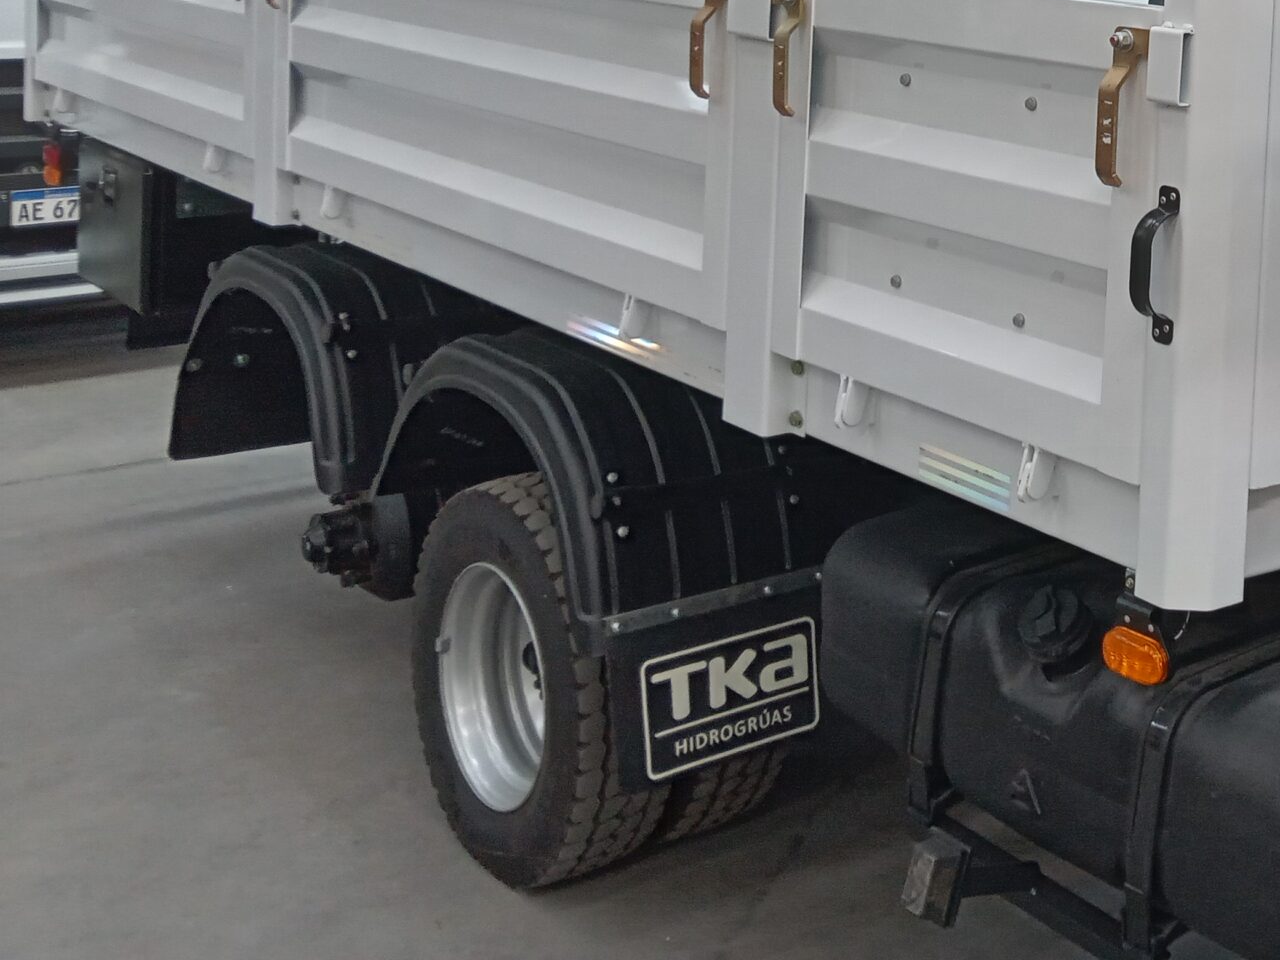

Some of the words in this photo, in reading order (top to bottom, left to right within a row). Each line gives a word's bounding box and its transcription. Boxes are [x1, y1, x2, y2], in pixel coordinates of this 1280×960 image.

[19, 202, 44, 222] AE
[53, 199, 78, 219] 67
[651, 634, 809, 721] TKa
[674, 705, 793, 757] HIDROGRÚAS
